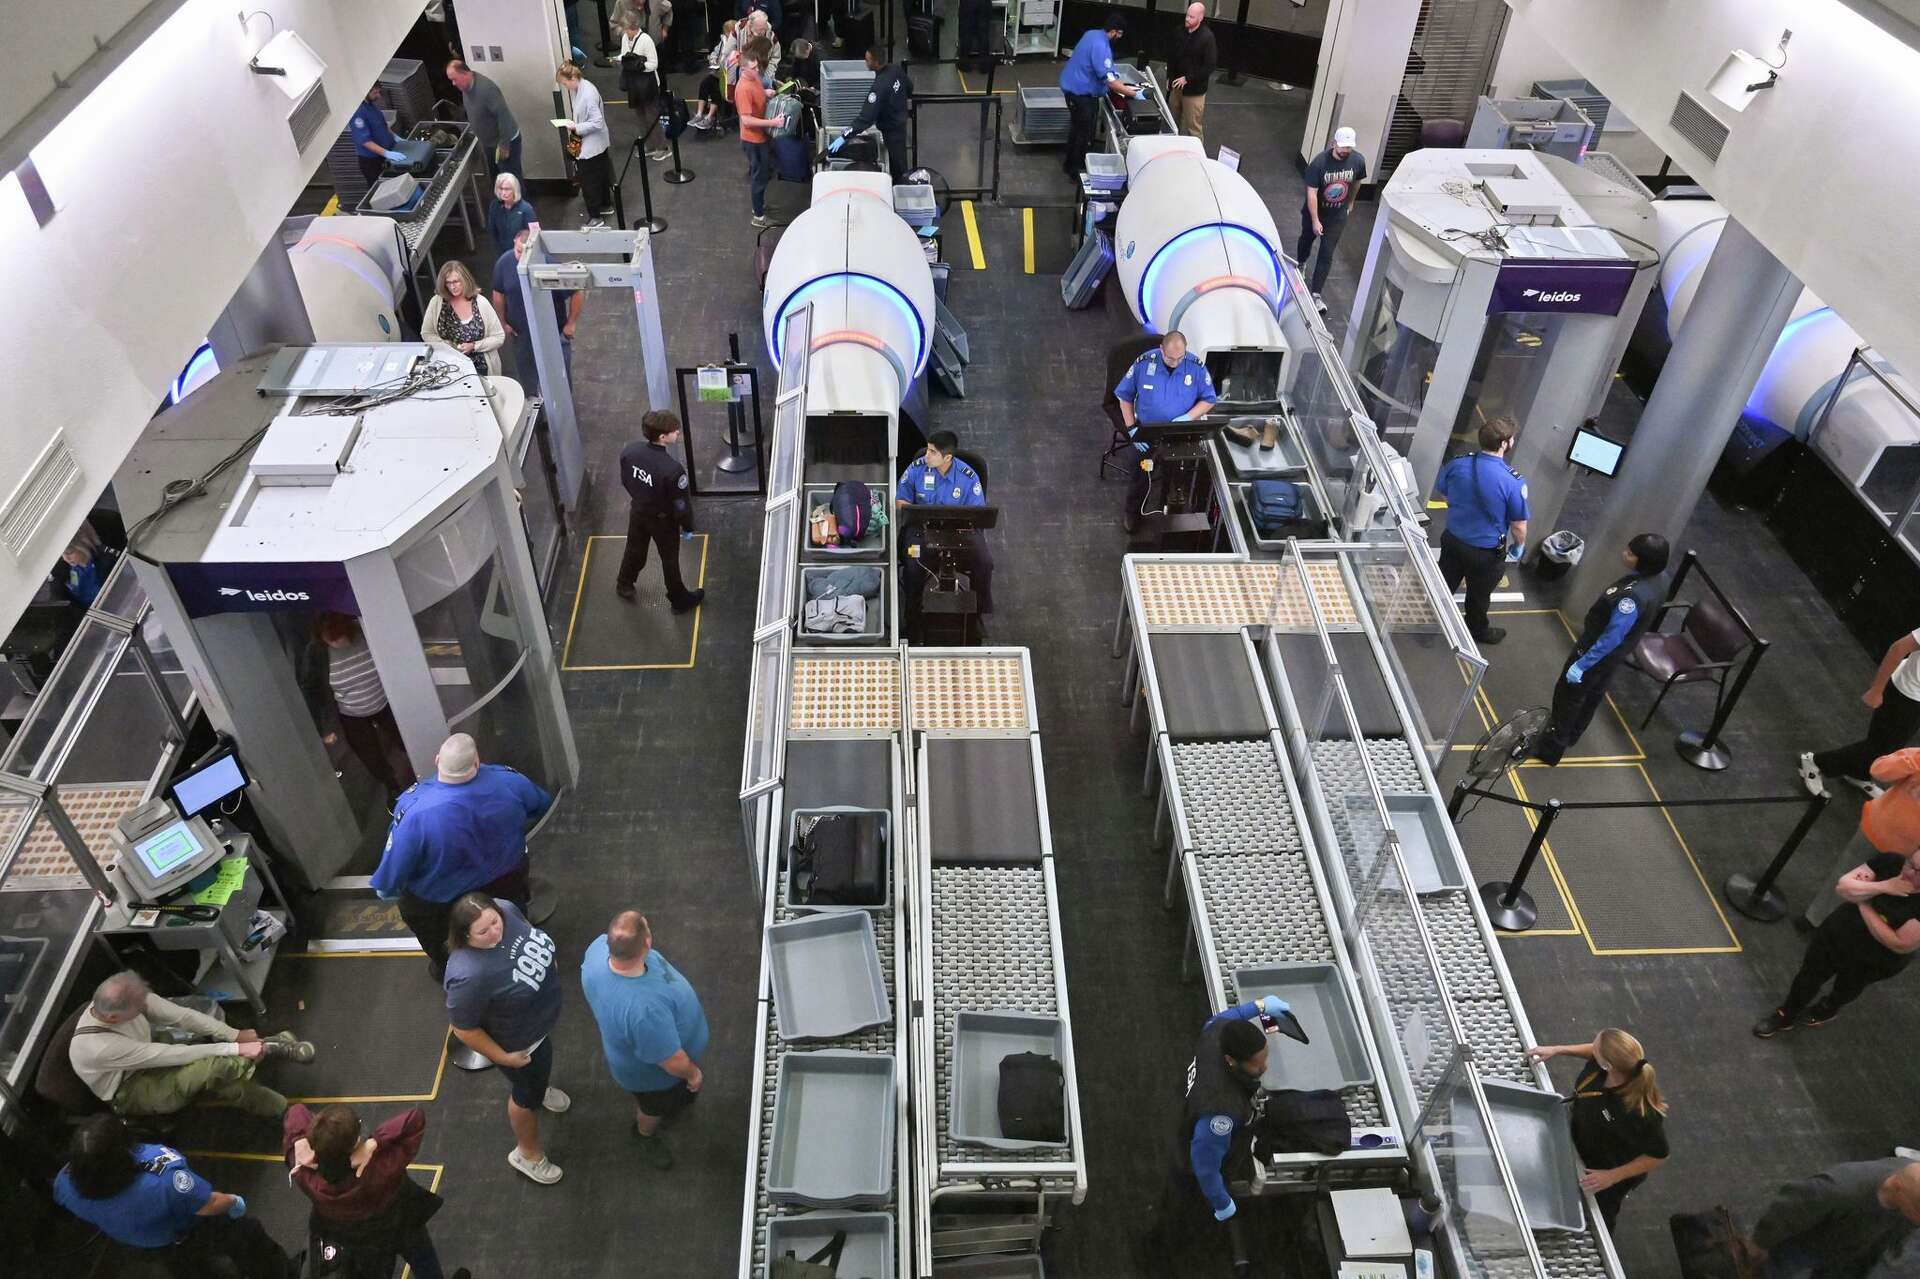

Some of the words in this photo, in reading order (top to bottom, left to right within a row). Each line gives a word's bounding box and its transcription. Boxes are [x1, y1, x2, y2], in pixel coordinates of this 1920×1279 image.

[1538, 291, 1581, 302] leidos
[632, 465, 653, 487] TSA
[246, 589, 310, 601] leidos
[512, 927, 556, 992] 1985
